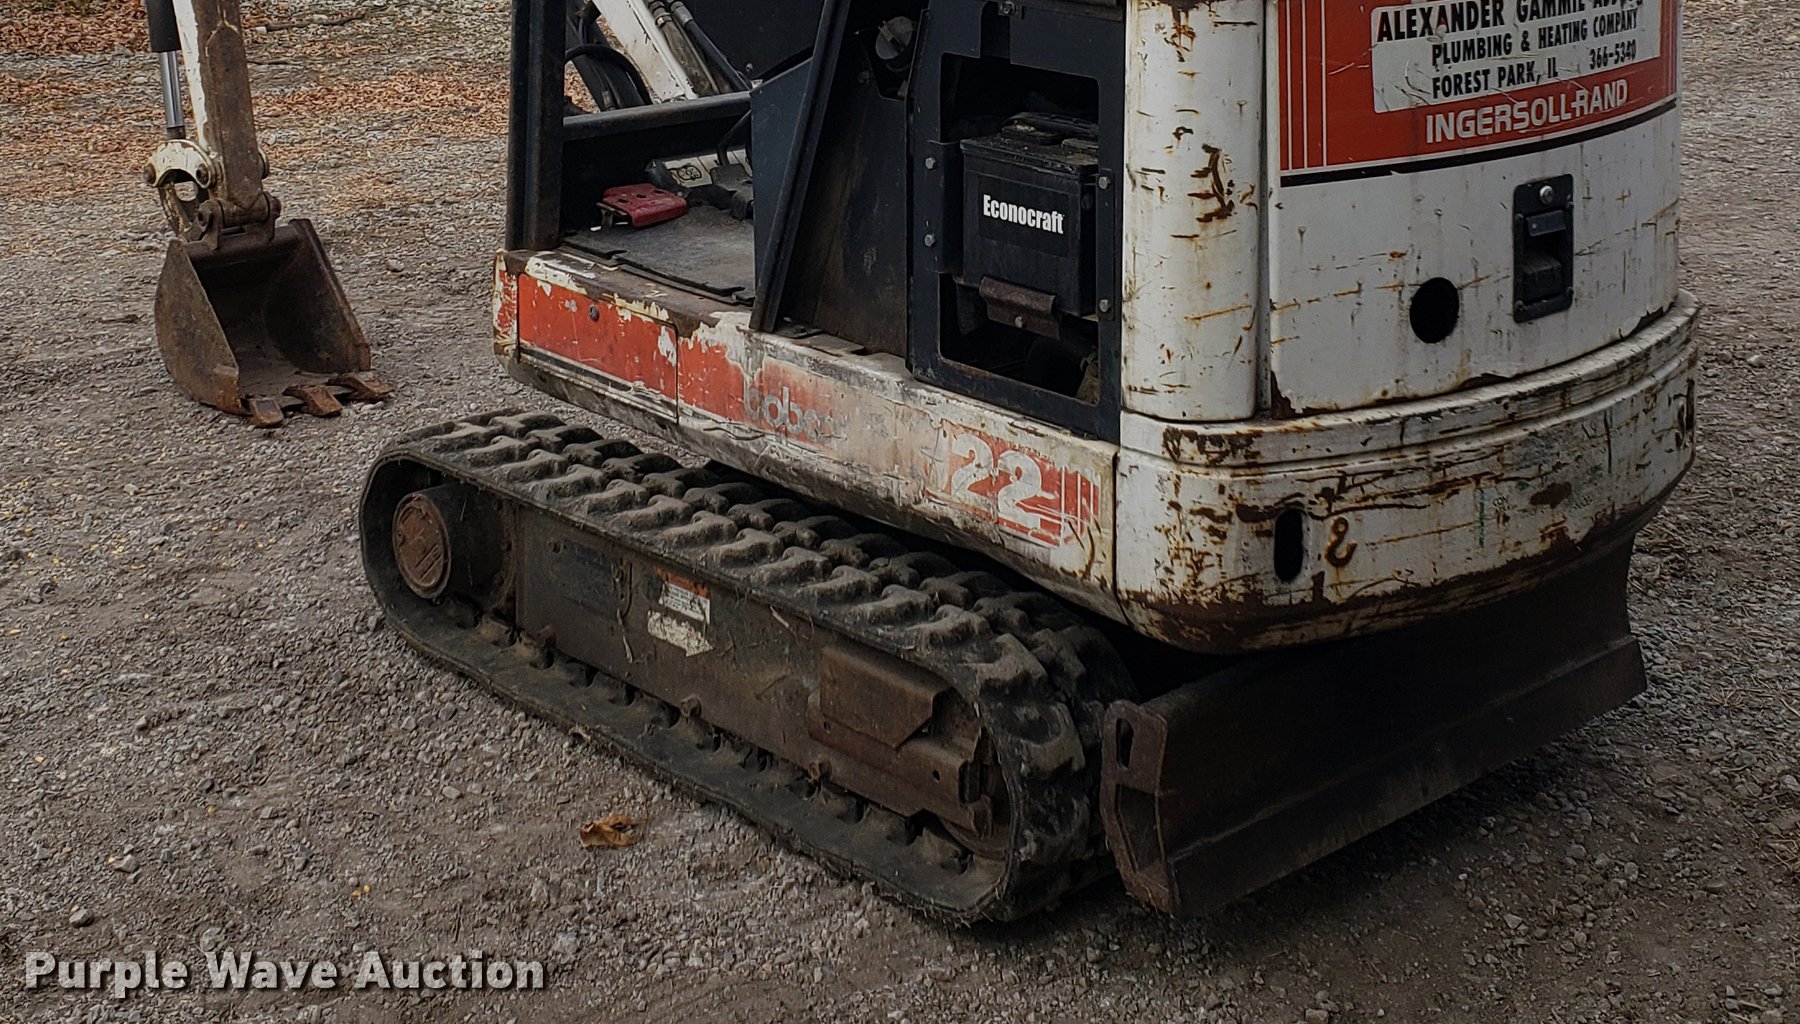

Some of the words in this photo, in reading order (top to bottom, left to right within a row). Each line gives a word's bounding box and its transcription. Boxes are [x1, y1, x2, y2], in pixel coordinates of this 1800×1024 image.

[1432, 33, 1513, 66] PLUMBING
[1521, 30, 1531, 52] &
[1538, 18, 1588, 49] HEATING
[1593, 8, 1638, 38] COMPANY
[1432, 69, 1490, 99] FOREST
[1497, 61, 1541, 86] PARK,
[1547, 57, 1558, 78] IL
[1589, 38, 1637, 70] 366-5340
[1426, 79, 1628, 144] INGERSOLL-RAND
[983, 194, 1064, 234] Econocraft
